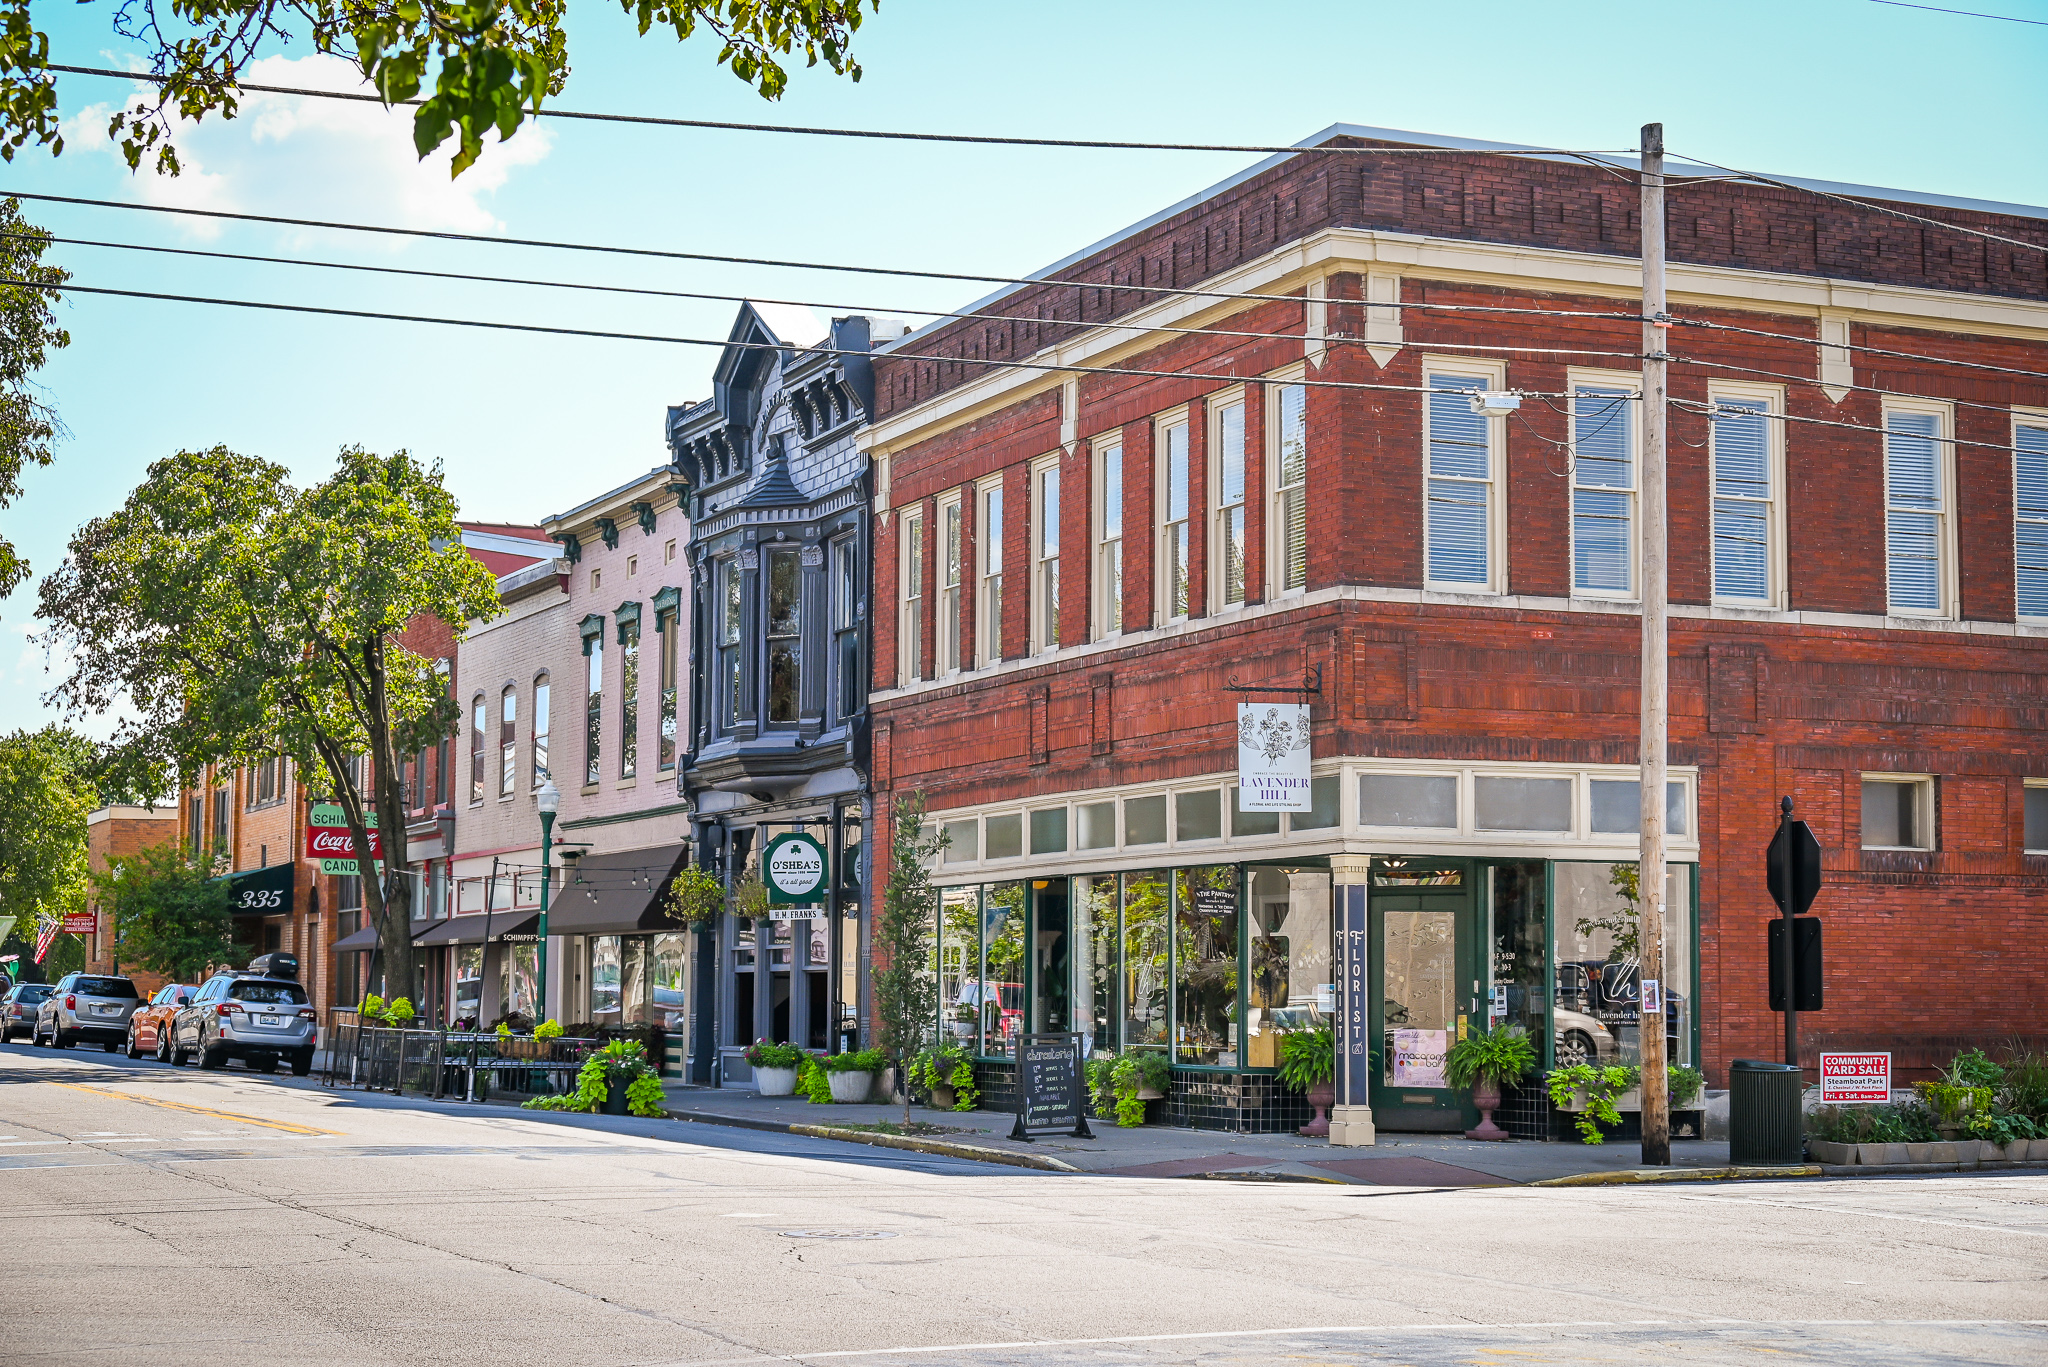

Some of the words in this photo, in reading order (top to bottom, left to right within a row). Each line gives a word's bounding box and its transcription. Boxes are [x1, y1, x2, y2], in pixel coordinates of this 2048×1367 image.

[1241, 777, 1309, 788] LAVENDER
[1261, 790, 1291, 800] HILL
[773, 861, 820, 869] O'SHEA'S
[238, 890, 284, 908] 335
[791, 910, 817, 918] FRANKS
[1336, 930, 1344, 1038] FLORIST
[1350, 930, 1364, 1038] FLORIST
[1599, 1011, 1630, 1019] lavender
[1426, 1058, 1440, 1067] bar
[1825, 1057, 1886, 1065] COMMUNITY
[1825, 1065, 1857, 1075] YARD
[1858, 1065, 1886, 1075] SALE
